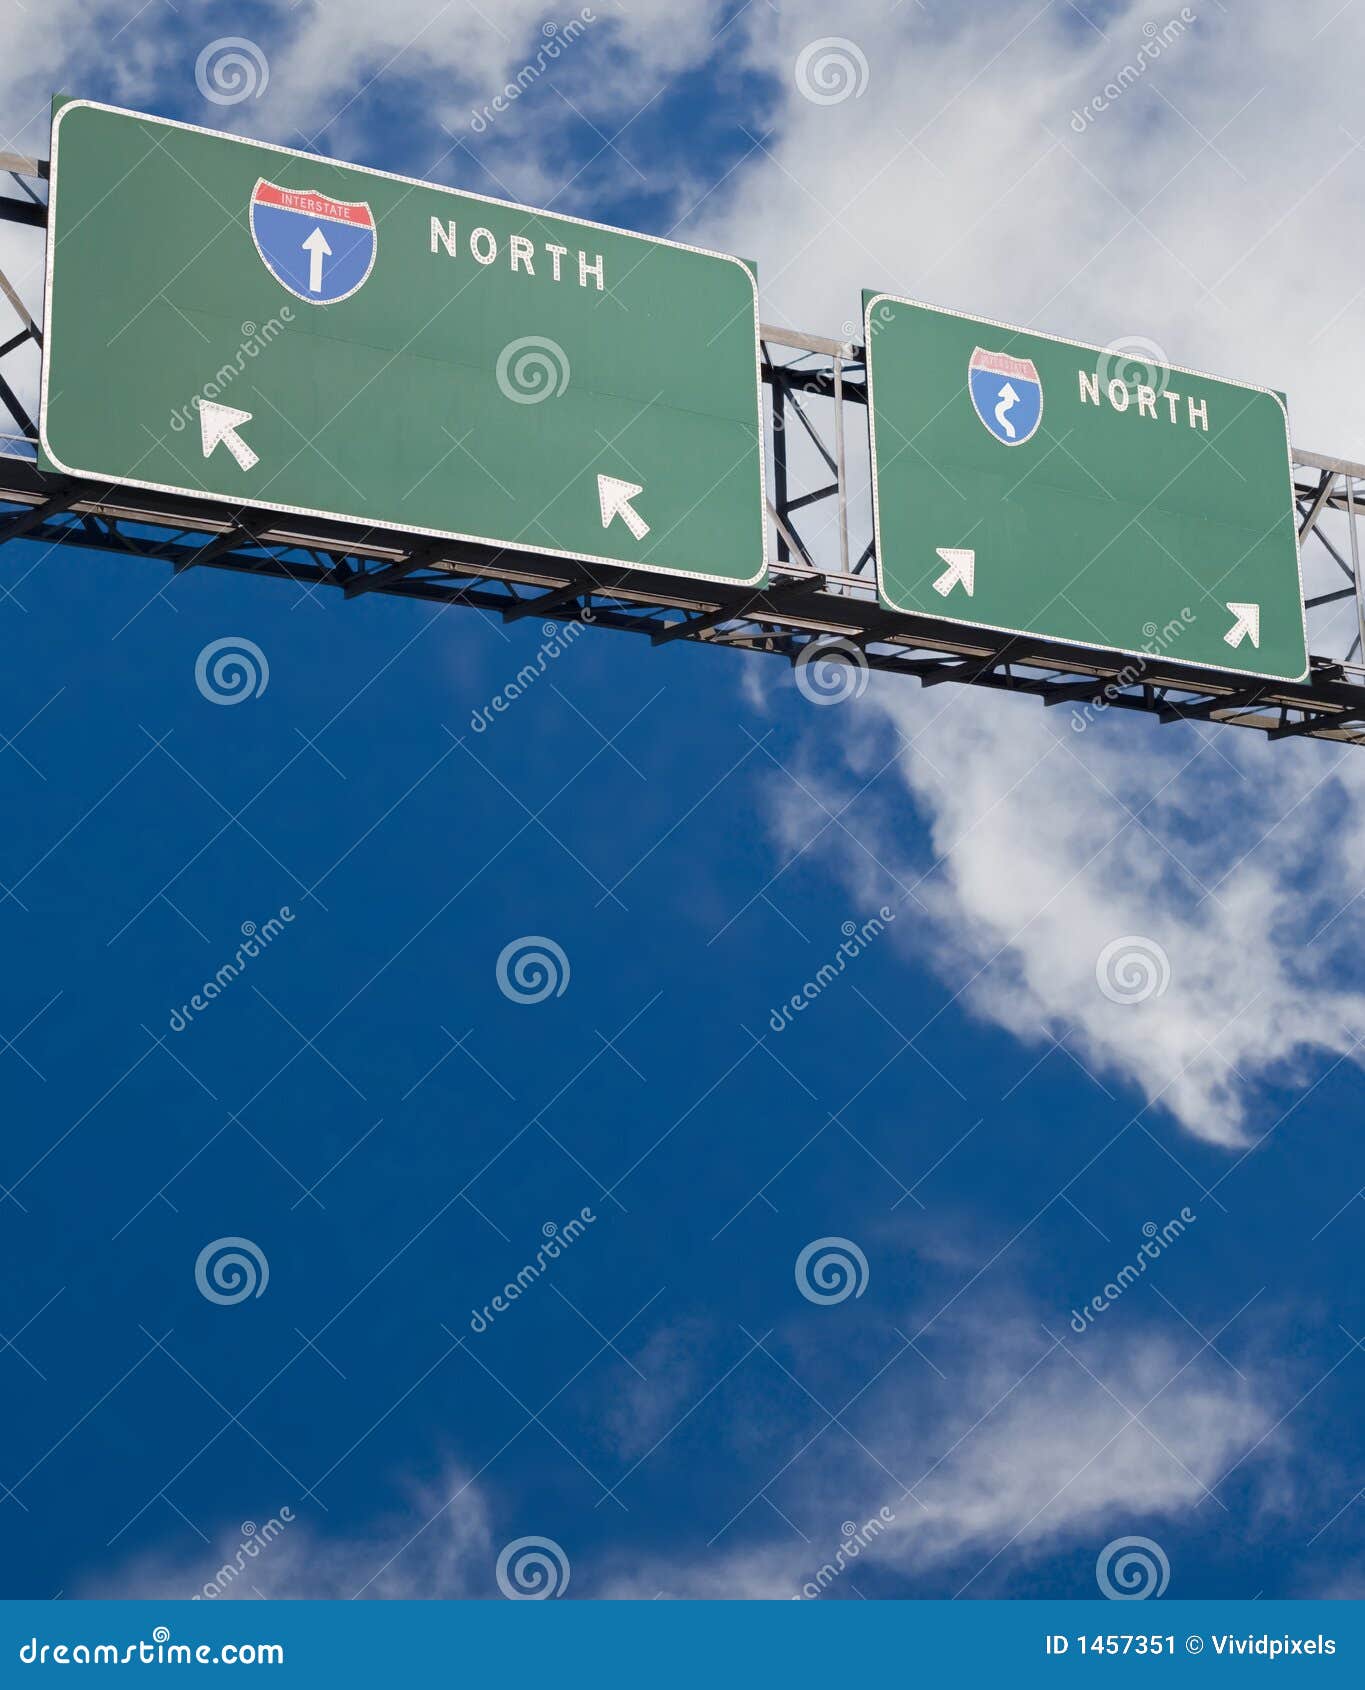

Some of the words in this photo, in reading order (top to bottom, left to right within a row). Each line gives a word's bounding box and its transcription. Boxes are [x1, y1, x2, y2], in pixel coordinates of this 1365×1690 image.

[281, 192, 351, 219] INTERSTATE
[430, 216, 604, 290] NORTH
[1078, 370, 1209, 431] NORTH
